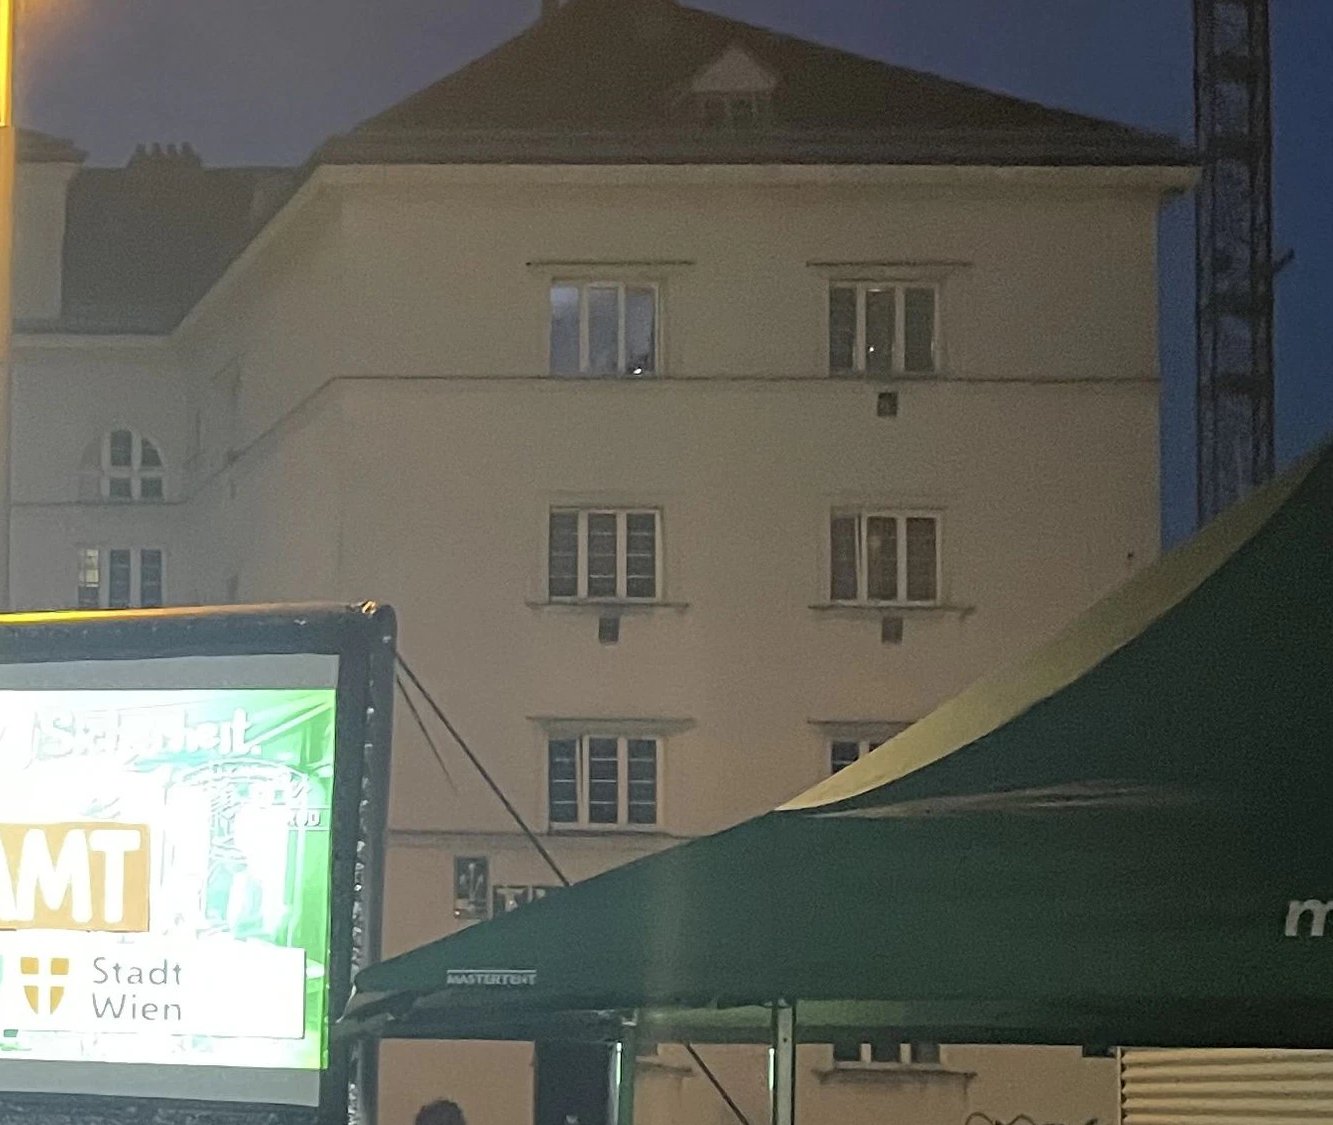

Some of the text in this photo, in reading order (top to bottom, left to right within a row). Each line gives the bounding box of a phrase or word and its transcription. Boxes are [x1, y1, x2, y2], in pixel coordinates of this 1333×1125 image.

[92, 957, 182, 985] Stadt
[446, 973, 537, 985] MASTERTENT
[92, 993, 182, 1021] Wien
